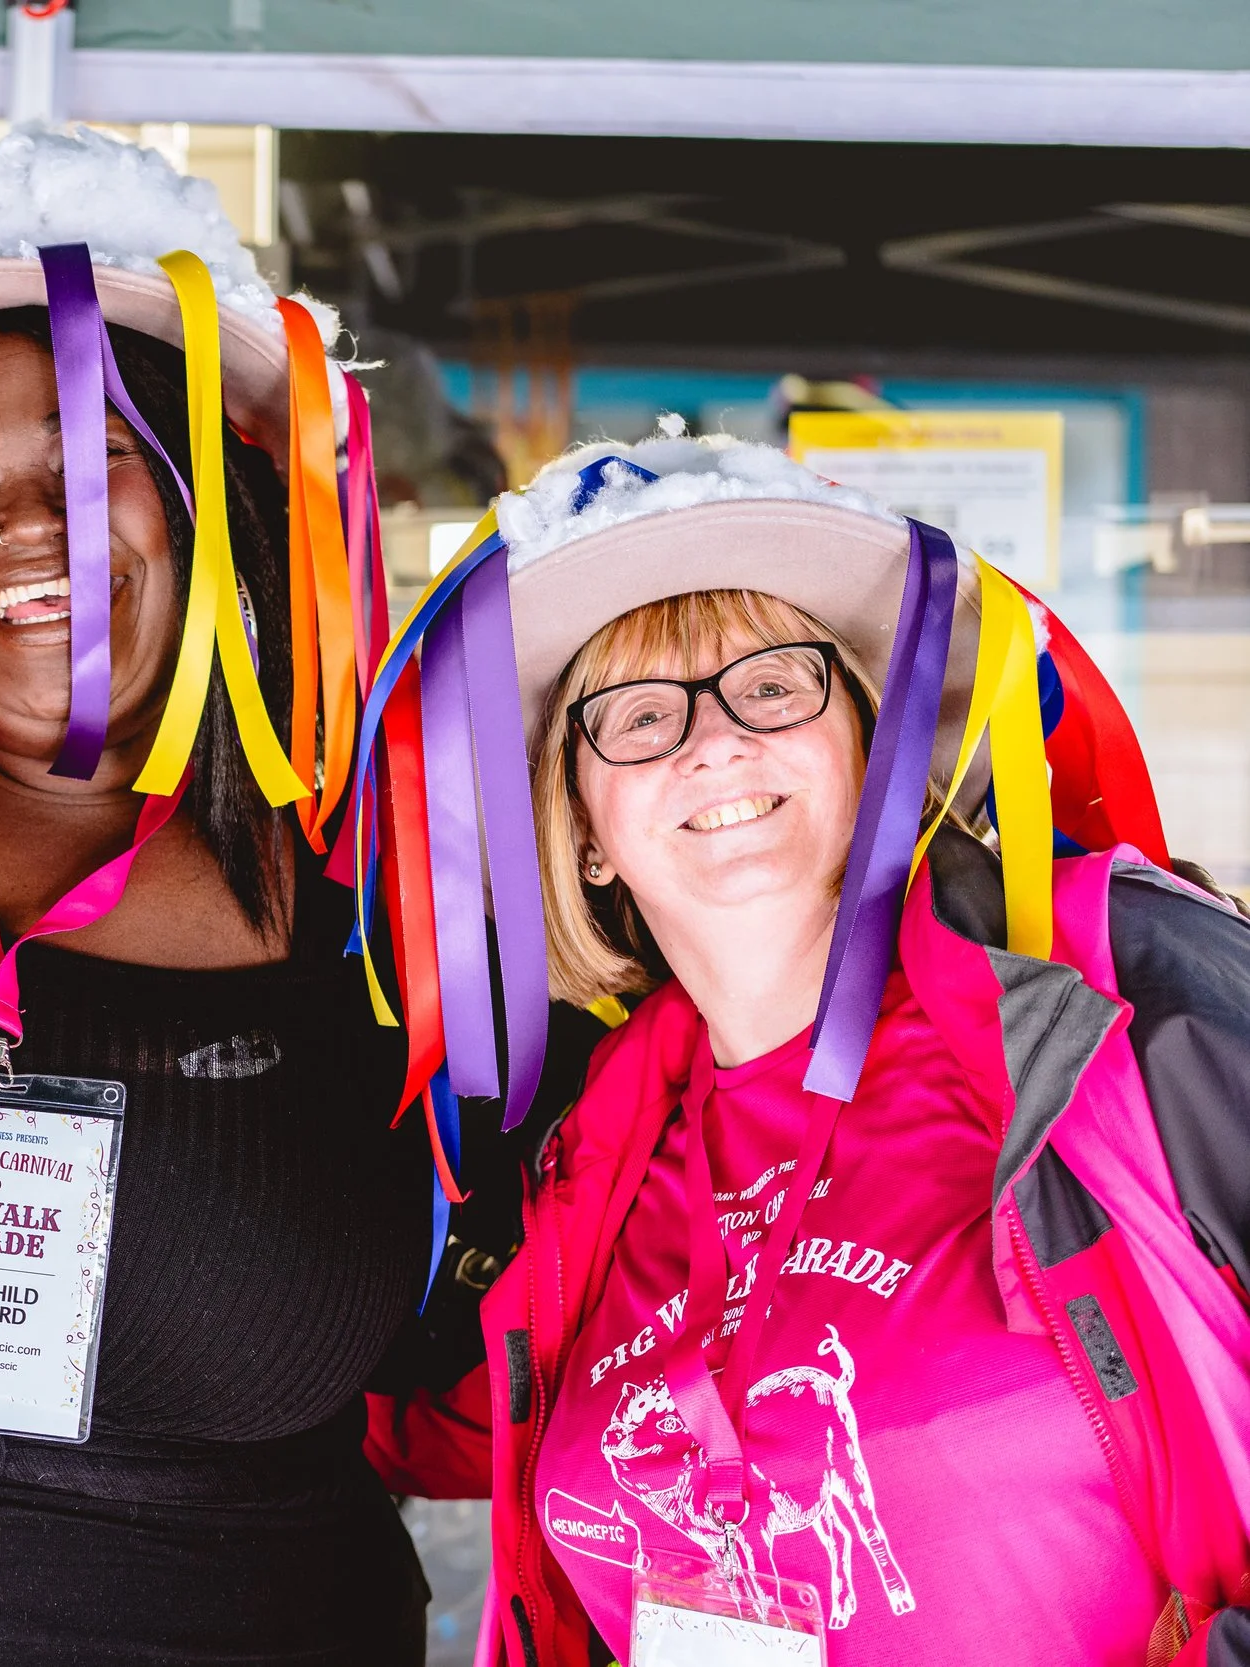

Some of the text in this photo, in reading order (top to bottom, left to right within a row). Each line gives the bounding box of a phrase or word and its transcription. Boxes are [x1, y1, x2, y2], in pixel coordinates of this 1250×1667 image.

[15, 1133, 49, 1145] PRESENTS
[0, 1150, 74, 1183] CARNIVAL
[741, 1230, 762, 1249] AND
[590, 1237, 913, 1388] PIG WLK ARADE
[719, 1319, 742, 1338] APR
[551, 1518, 626, 1544] #BEMOREPIG
